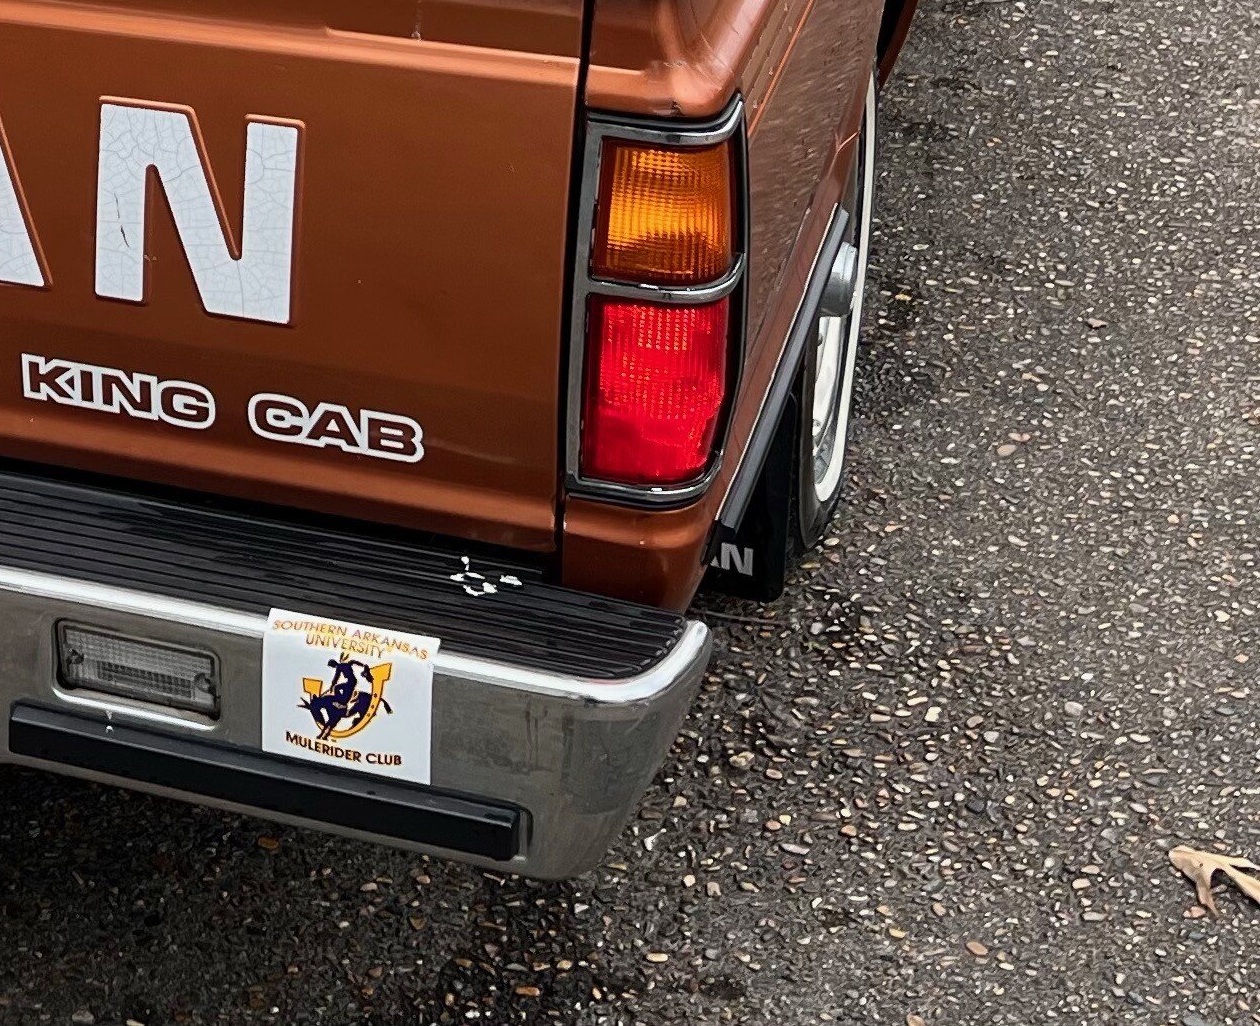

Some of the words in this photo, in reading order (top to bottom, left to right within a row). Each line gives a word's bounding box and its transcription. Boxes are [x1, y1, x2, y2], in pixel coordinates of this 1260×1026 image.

[20, 353, 217, 429] KING
[247, 392, 425, 464] CAB
[272, 619, 348, 637] SOUTHERN
[352, 628, 429, 660] ARKANSAS
[305, 633, 387, 659] UNIVERSITY
[285, 730, 362, 763] MULERIDER
[365, 752, 403, 767] CLUB
